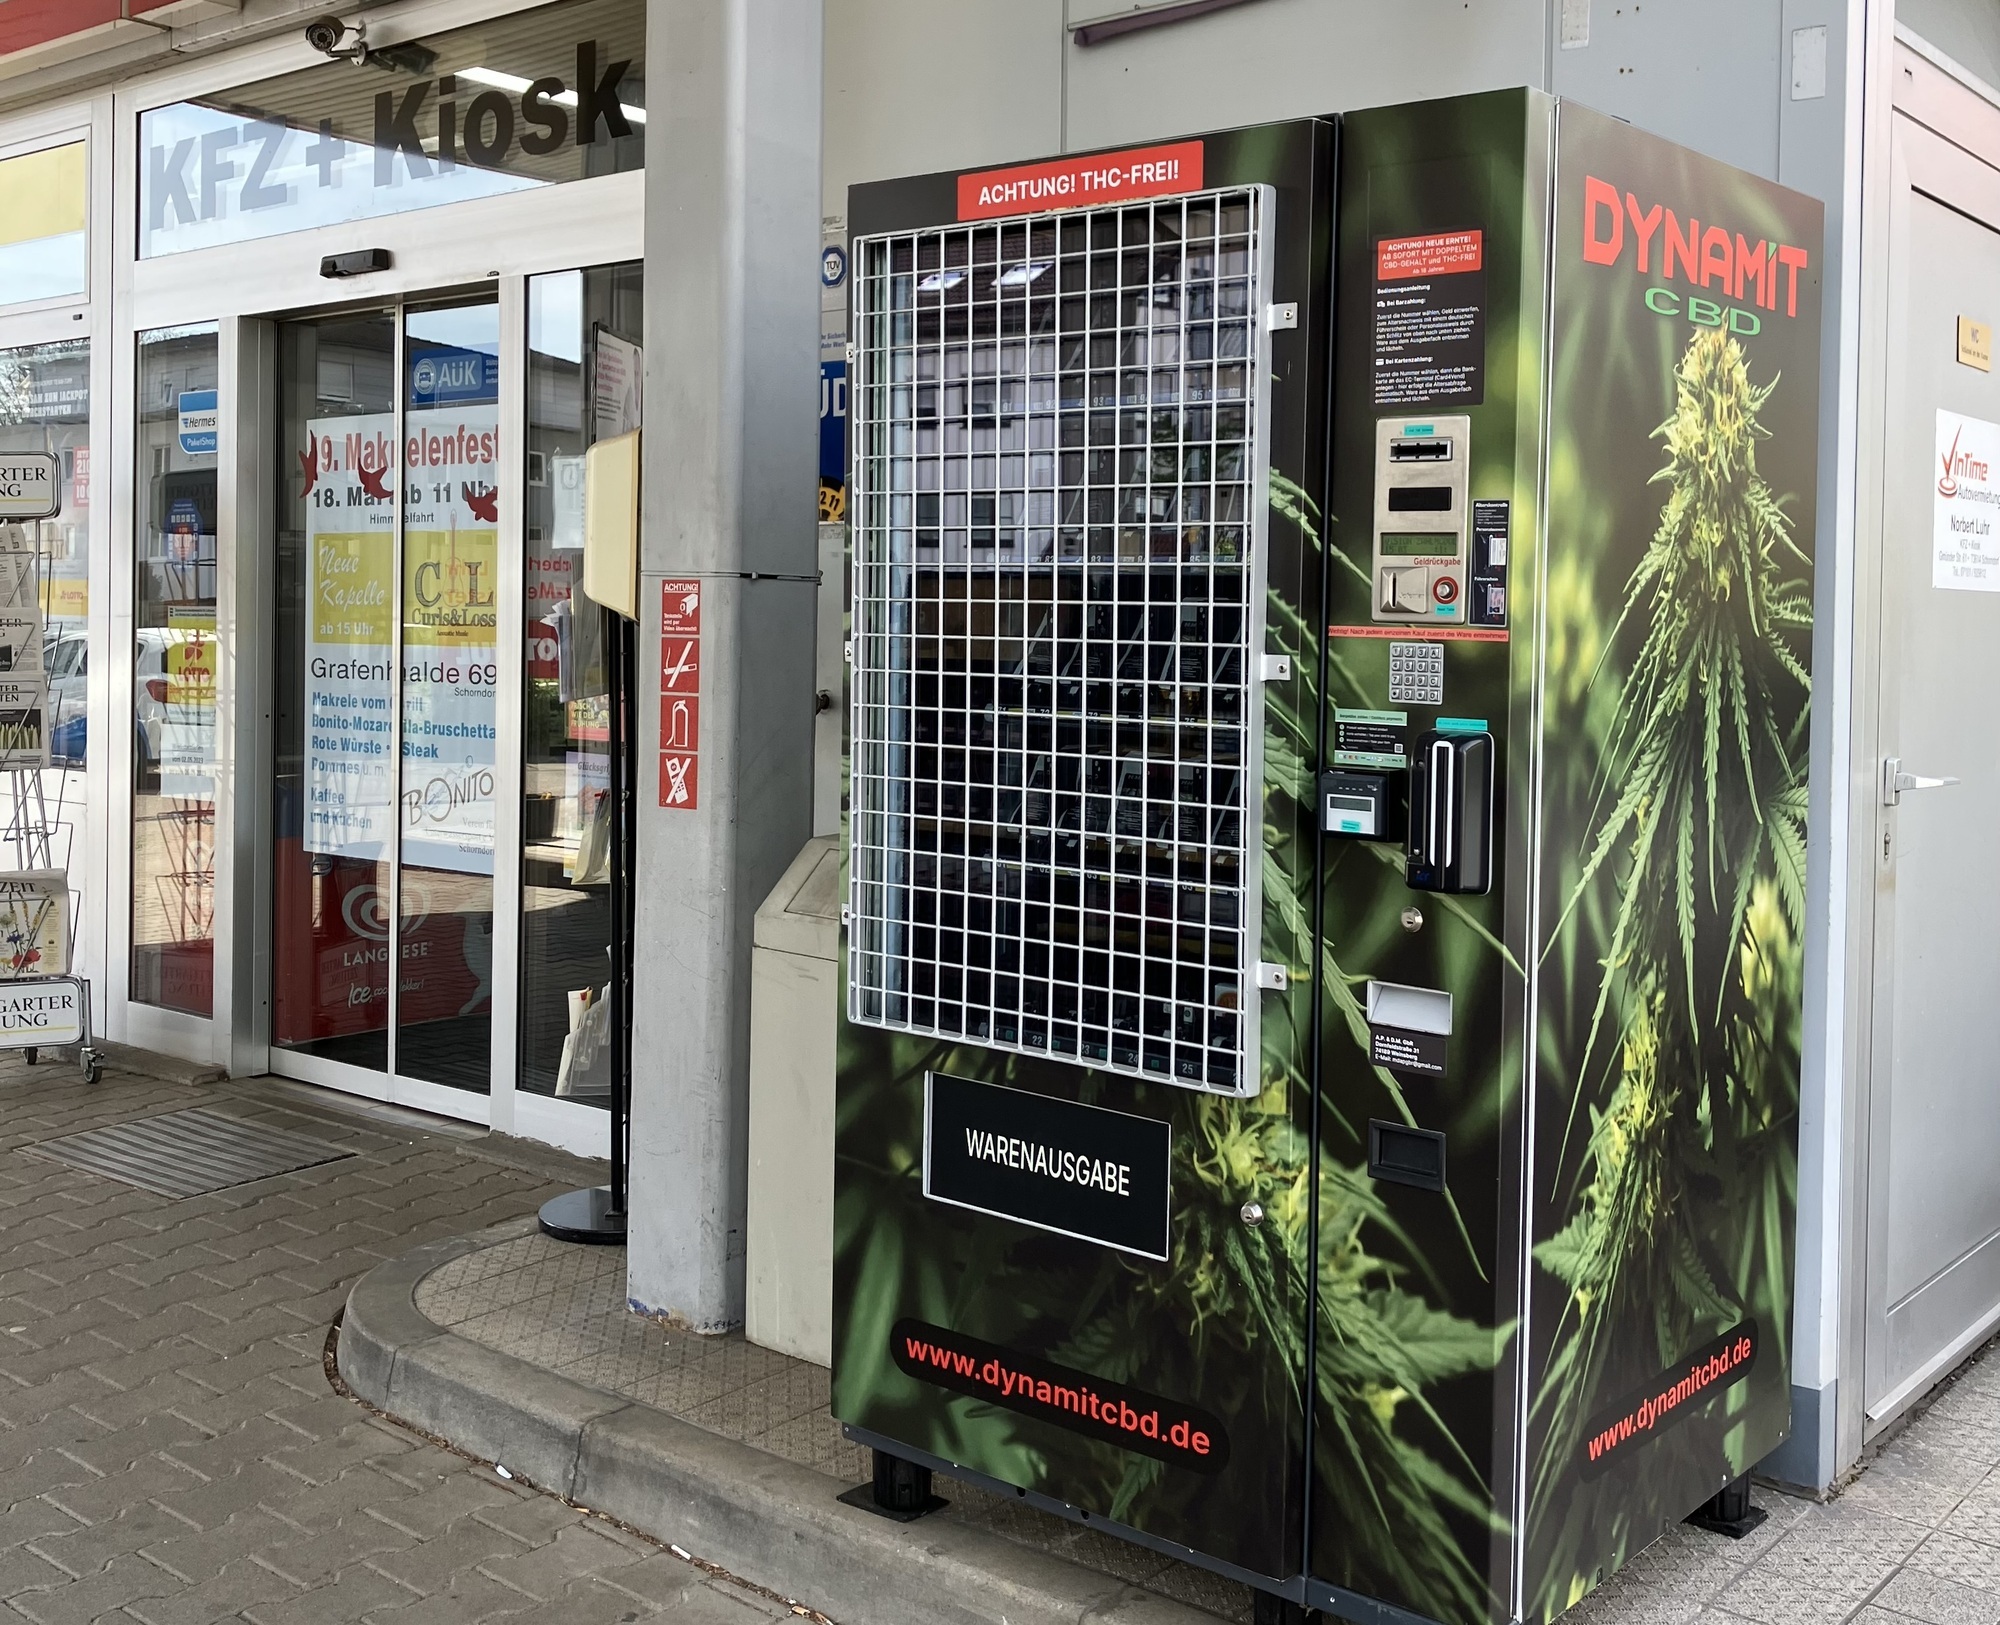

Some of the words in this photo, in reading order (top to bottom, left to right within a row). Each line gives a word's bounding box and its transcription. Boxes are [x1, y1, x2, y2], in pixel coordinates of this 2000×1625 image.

[150, 115, 287, 231] KFZ
[306, 118, 346, 188] +
[375, 40, 634, 188] Kiosk
[978, 173, 1076, 206] ACHTUNG!
[1080, 159, 1179, 191] THC-FREI!
[1388, 243, 1424, 251] ACHTUNG!
[1426, 238, 1444, 247] NEUE
[1446, 236, 1471, 245] ERNTE!
[1393, 249, 1419, 259] SOFORT
[1422, 248, 1434, 256] MIT
[1436, 244, 1477, 254] DOPPELTEM
[1583, 175, 1808, 318] DYNAMIT
[1384, 259, 1426, 269] CBD-GEHALT
[1443, 253, 1475, 262] THC-FREI
[1645, 287, 1761, 336] CBD
[59, 389, 88, 401] JACKPOT
[189, 417, 216, 428] Hermes
[187, 436, 216, 447] PaketShop
[0, 467, 48, 481] RTER
[1953, 451, 1988, 481] InTime
[0, 483, 21, 497] NG
[313, 488, 341, 508] 18.
[433, 482, 452, 503] 11
[1958, 484, 2000, 509] Autovermietung
[1951, 514, 1975, 534] Norbert
[1976, 518, 1991, 536] Luhr
[319, 547, 360, 574] Neue
[1414, 558, 1460, 567] Geldrückgabe
[415, 561, 443, 607] C
[464, 561, 494, 608] L
[664, 583, 699, 592] ACHTUNG!
[319, 578, 385, 615] Kapelle
[411, 606, 497, 628] Curls&Loss
[320, 622, 333, 636] ab
[336, 622, 351, 636] 15
[353, 622, 374, 636] Uhr
[178, 666, 210, 683] LOTTO
[469, 663, 497, 686] 69
[312, 691, 358, 708] Makrele
[361, 697, 386, 710] vom
[312, 735, 337, 750] Rote
[340, 737, 382, 754] Würste
[402, 741, 439, 759] Steak
[312, 757, 360, 775] Pommes
[311, 787, 345, 804] Kaffee
[402, 767, 494, 826] BONITO
[310, 810, 329, 825] und
[332, 811, 372, 829] Kuchen
[0, 882, 35, 893] ZEIT
[343, 941, 429, 968] LANGESE
[2, 1013, 48, 1029] UNG
[1032, 1035, 1043, 1045] 22
[1182, 1063, 1194, 1075] 25
[966, 1127, 1131, 1197] WARENAUSGABE
[906, 1337, 1210, 1455] www.dynamitcbd.de
[1588, 1336, 1751, 1461] www.dynamitcbd.de
